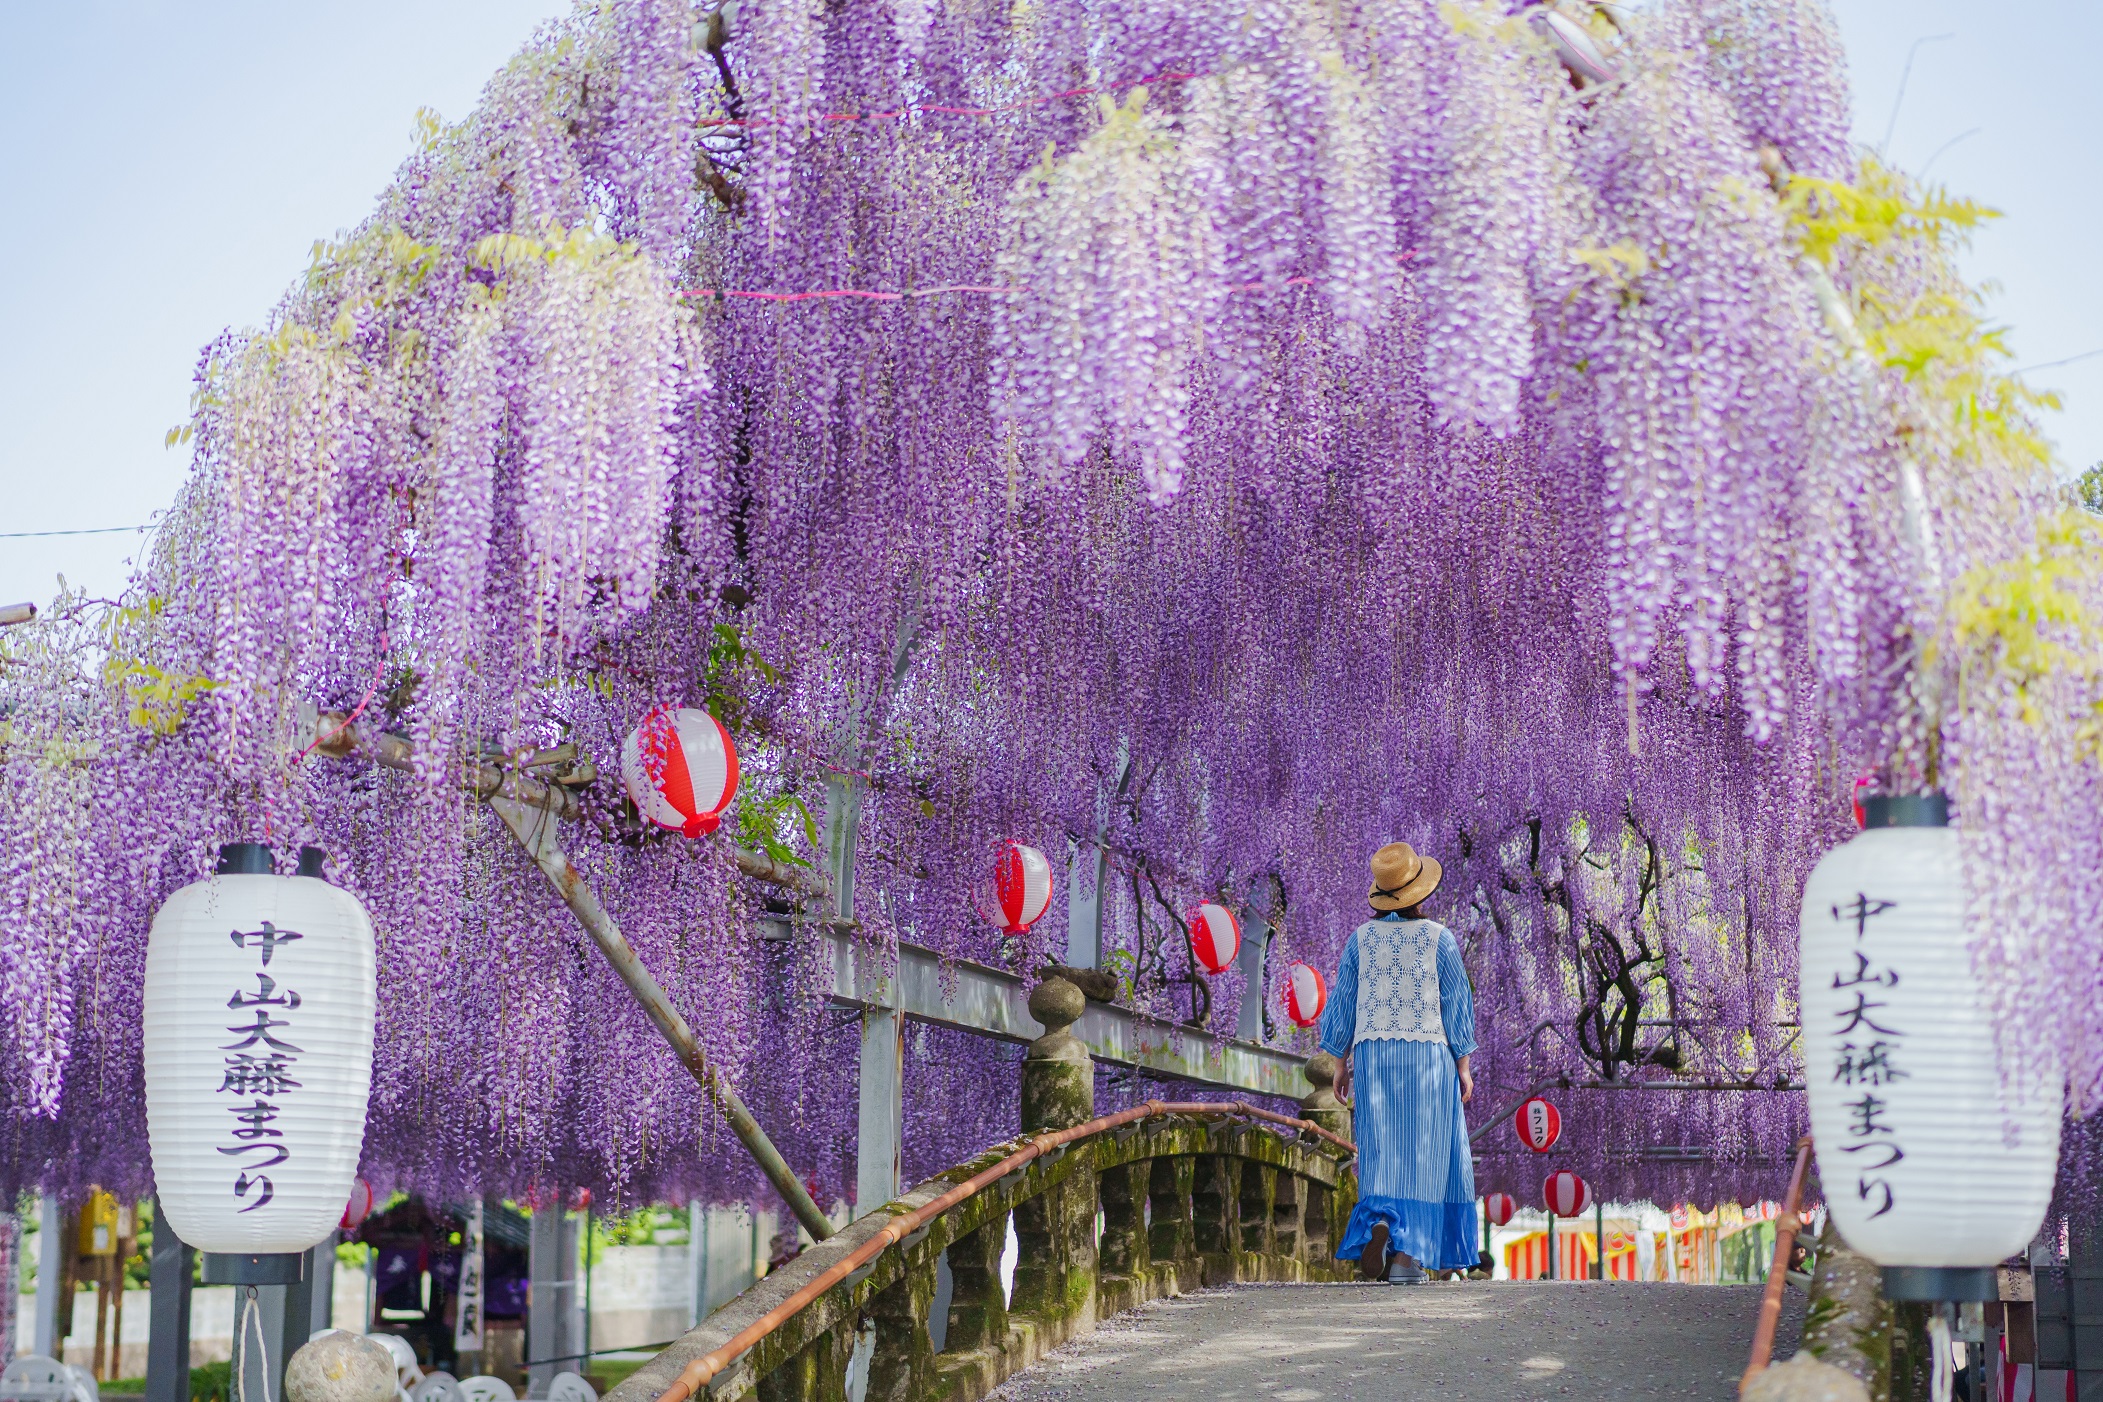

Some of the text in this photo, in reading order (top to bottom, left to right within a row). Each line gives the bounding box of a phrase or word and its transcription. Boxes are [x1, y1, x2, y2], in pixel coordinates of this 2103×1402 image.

[216, 921, 305, 1214] 中山大藤まつり
[1831, 892, 1909, 1221] 中山大藤まつり
